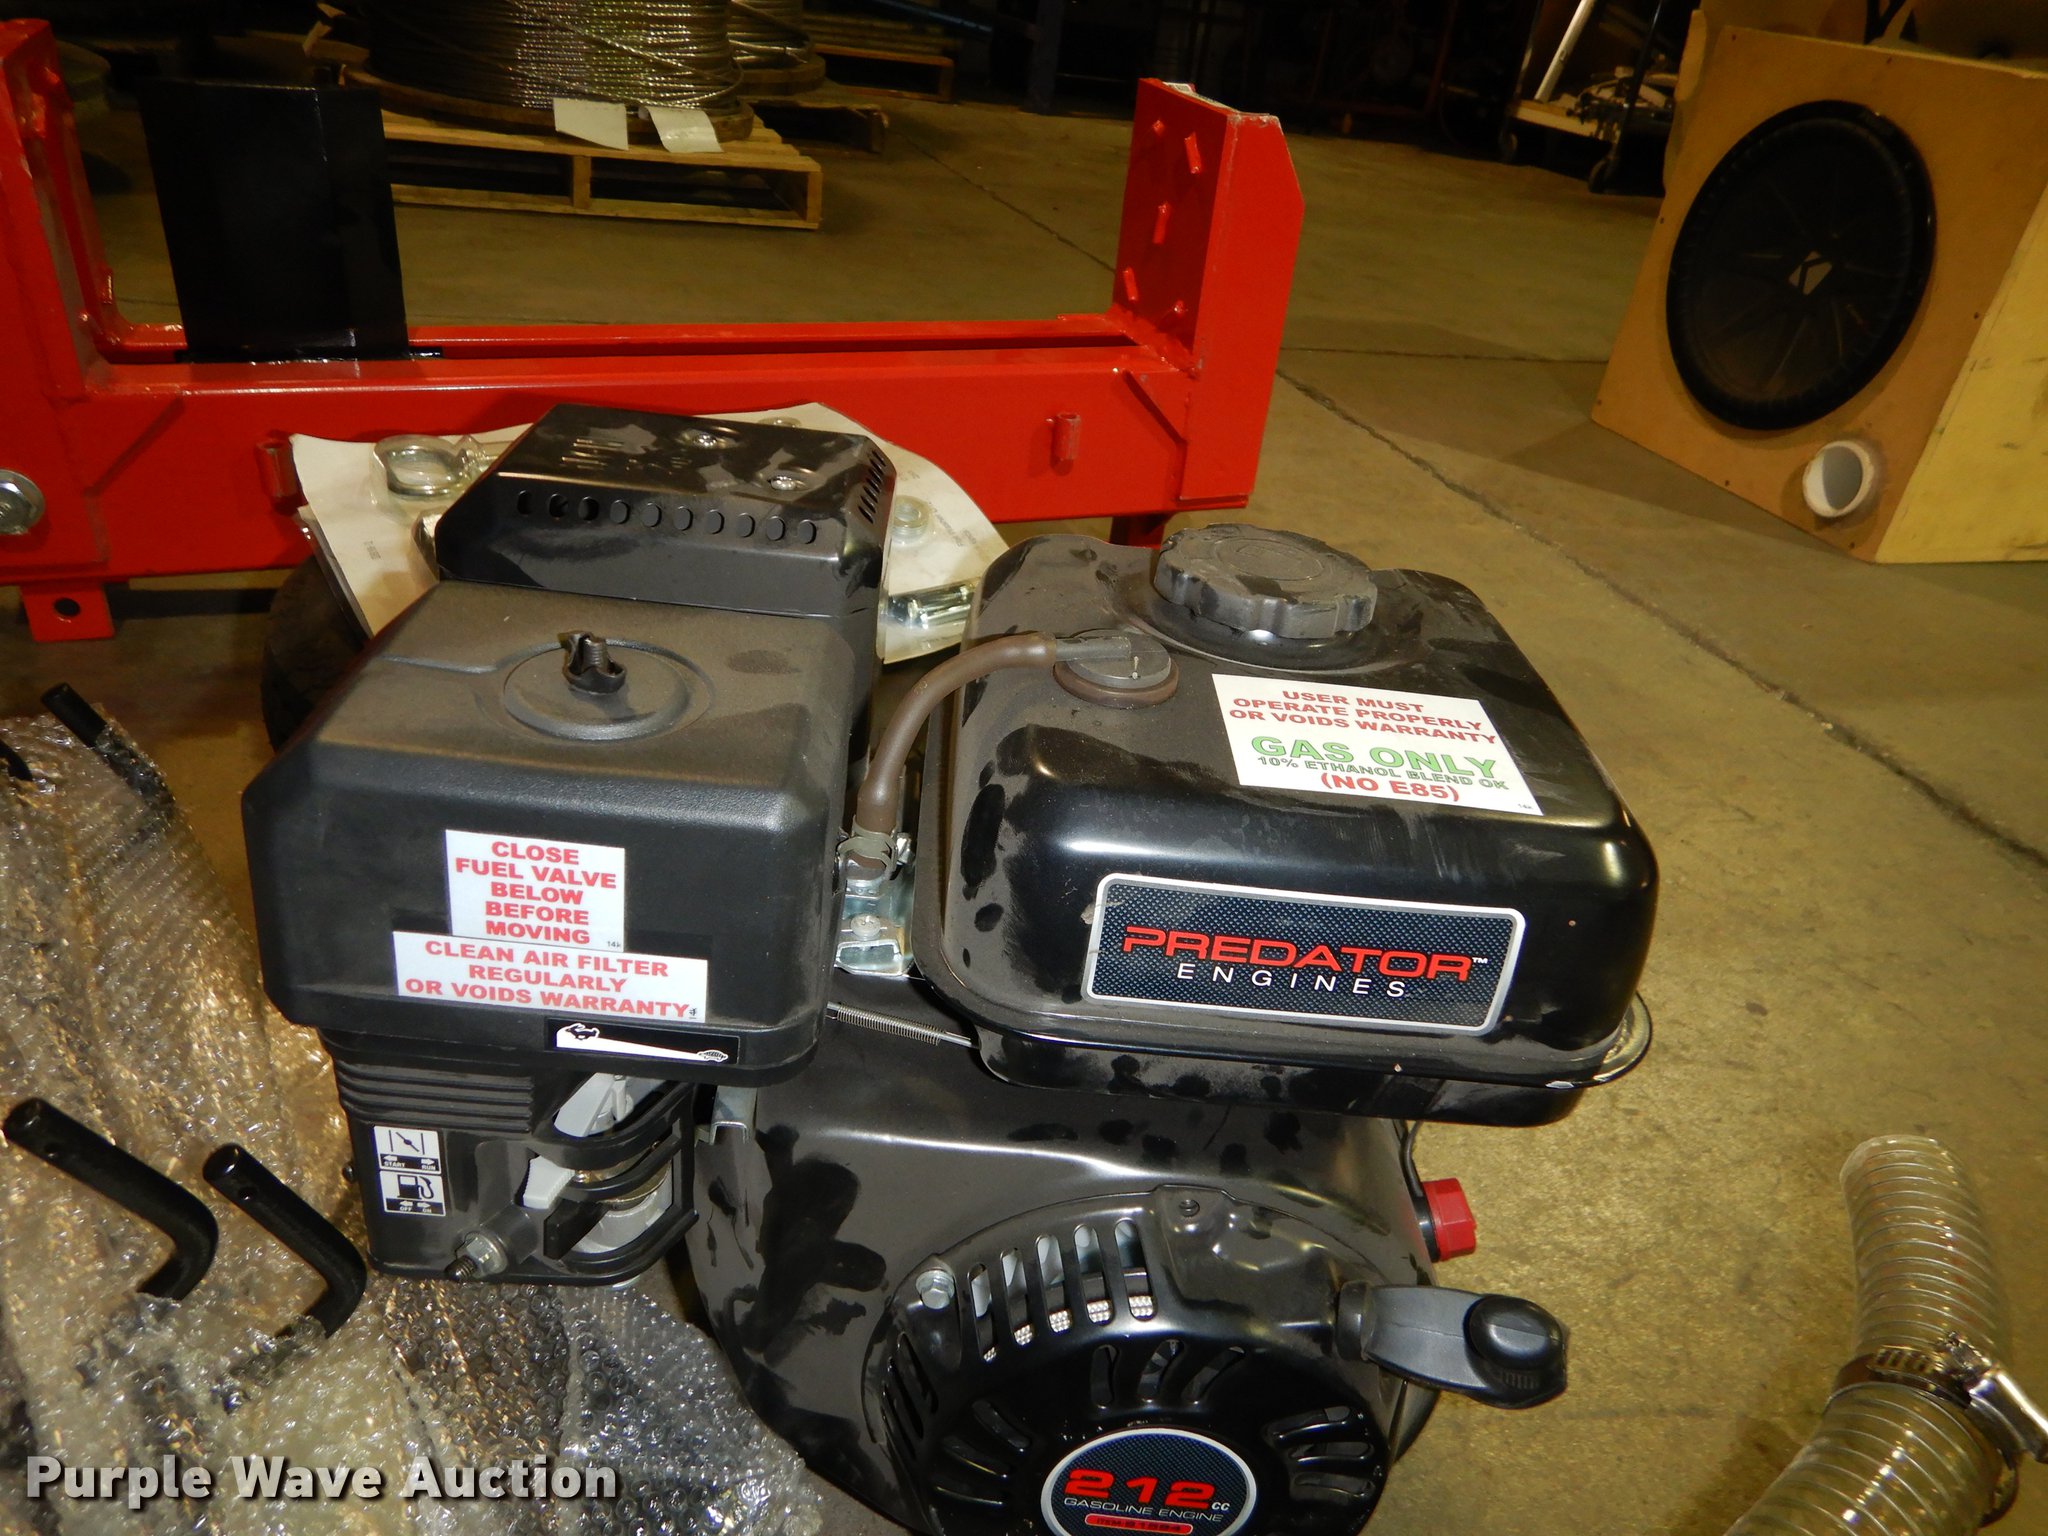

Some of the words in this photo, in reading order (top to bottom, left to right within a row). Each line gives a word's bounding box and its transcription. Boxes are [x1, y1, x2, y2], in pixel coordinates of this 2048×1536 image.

[1233, 698, 1349, 717] OPERATE
[1356, 709, 1482, 731] PROPERLY
[1282, 690, 1350, 705] USER
[1356, 698, 1424, 713] MUST
[1229, 709, 1264, 721] OR
[1273, 712, 1350, 728] VOIDS
[1356, 720, 1496, 744] WARRANTY
[1251, 735, 1355, 764] GAS
[1369, 746, 1497, 780] ONLY
[1257, 755, 1299, 769] 10%
[1305, 760, 1402, 779] ETHANOL
[1406, 770, 1473, 786] BLEND
[1480, 778, 1510, 790] OK
[1320, 772, 1380, 792] (NO
[1391, 780, 1459, 802] E85)
[491, 841, 579, 865] CLOSE
[455, 857, 524, 880] FUEL
[531, 865, 616, 889] VALVE
[491, 882, 583, 905] BELOW
[485, 901, 589, 926] BEFORE
[485, 920, 590, 945] MOVING
[425, 940, 514, 963] CLEAN
[523, 951, 569, 968] AIR
[577, 955, 669, 977] FILTER
[1123, 926, 1472, 982] PREDATOR
[468, 964, 627, 993] REGULARLY
[1177, 962, 1406, 998] ENGINES
[405, 978, 443, 996] OR
[451, 982, 533, 1004] VOIDS
[540, 991, 690, 1018] WARRANTY
[1064, 1468, 1216, 1510] 212
[1063, 1497, 1154, 1516] GASOLINE
[1158, 1508, 1224, 1523] ENGINE
